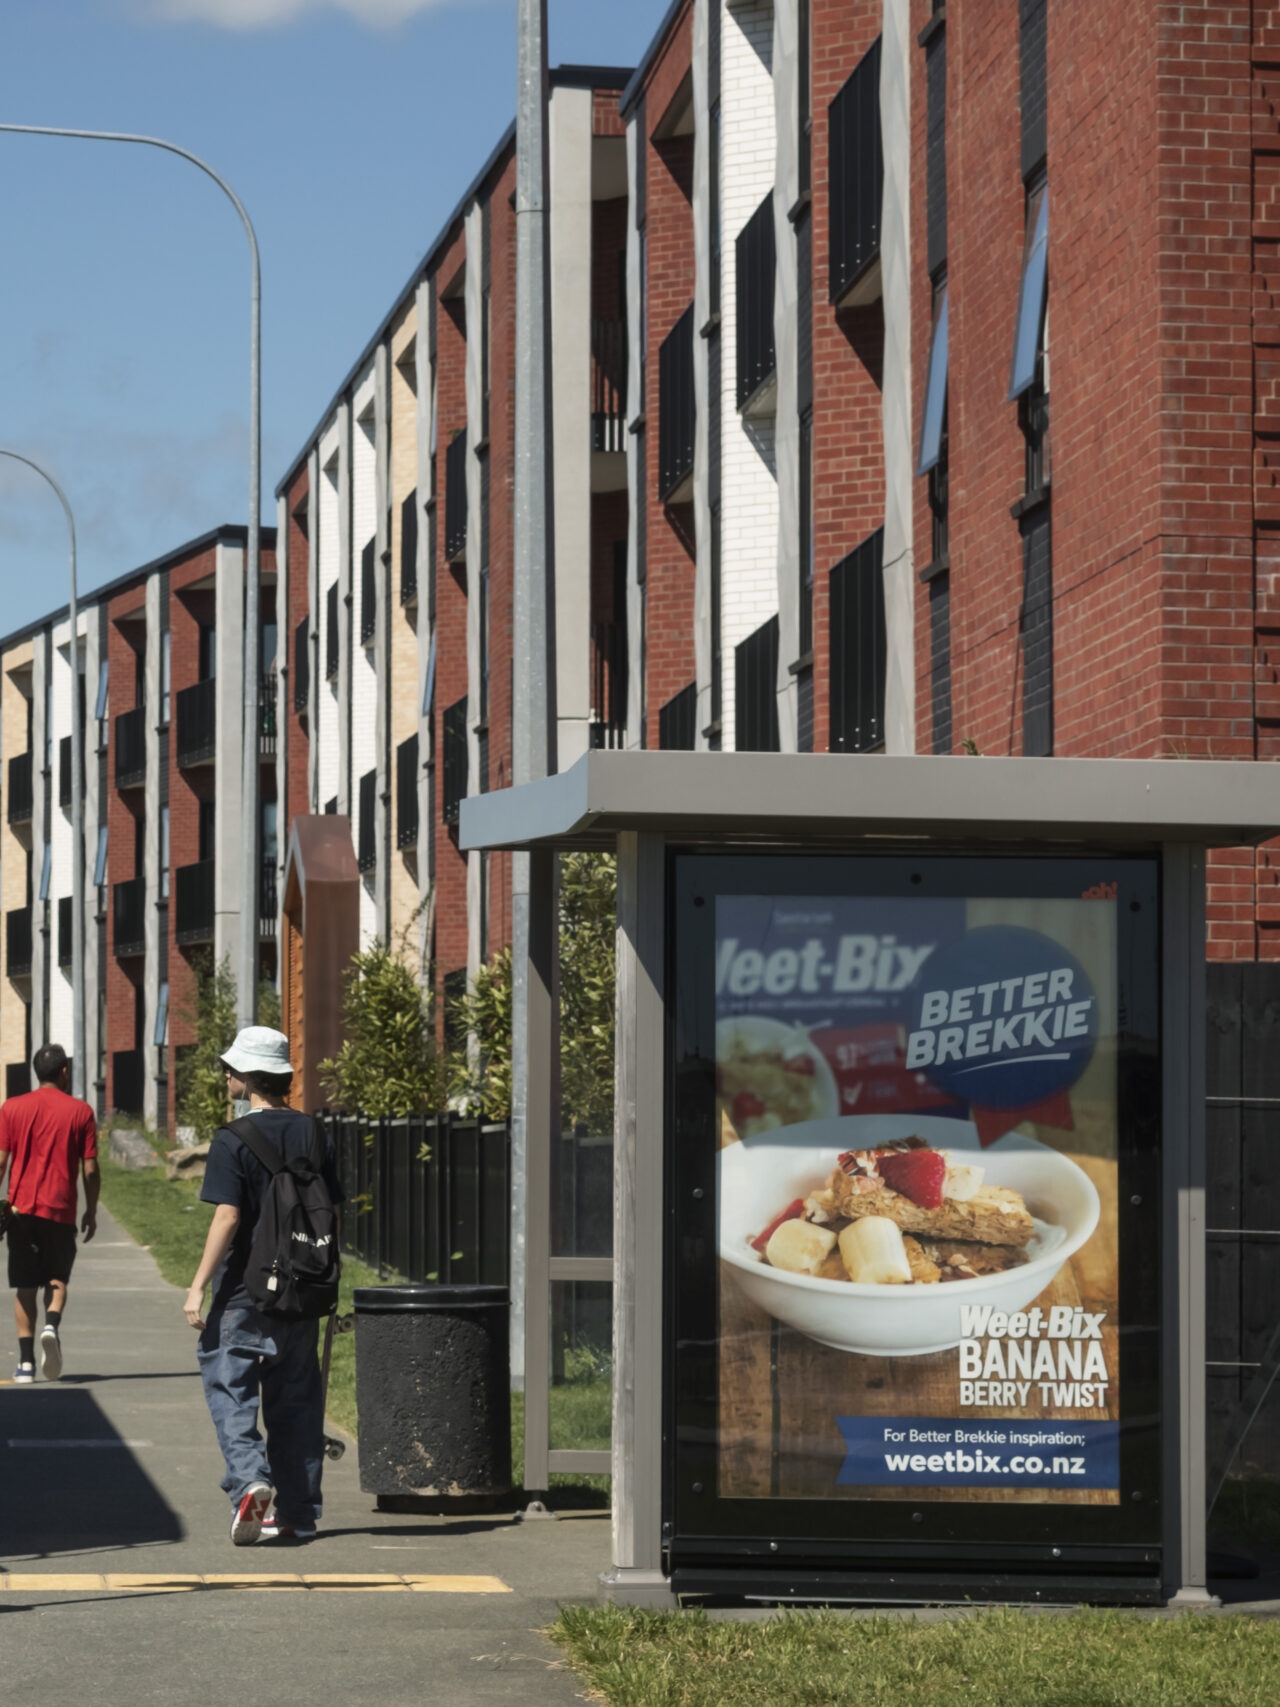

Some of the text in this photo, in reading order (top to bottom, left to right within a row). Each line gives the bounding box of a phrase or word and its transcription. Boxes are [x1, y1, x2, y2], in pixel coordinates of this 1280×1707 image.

[920, 968, 1074, 1028] BETTER
[905, 998, 1091, 1070] BREKKIE
[959, 1304, 1107, 1339] Weet-Bix
[959, 1339, 1109, 1381] BANANA
[959, 1381, 1109, 1408] BERRY TWIST
[883, 1429, 1086, 1446] For Better Brekkie inspiration;
[884, 1450, 1086, 1475] weetbix.co.nz
